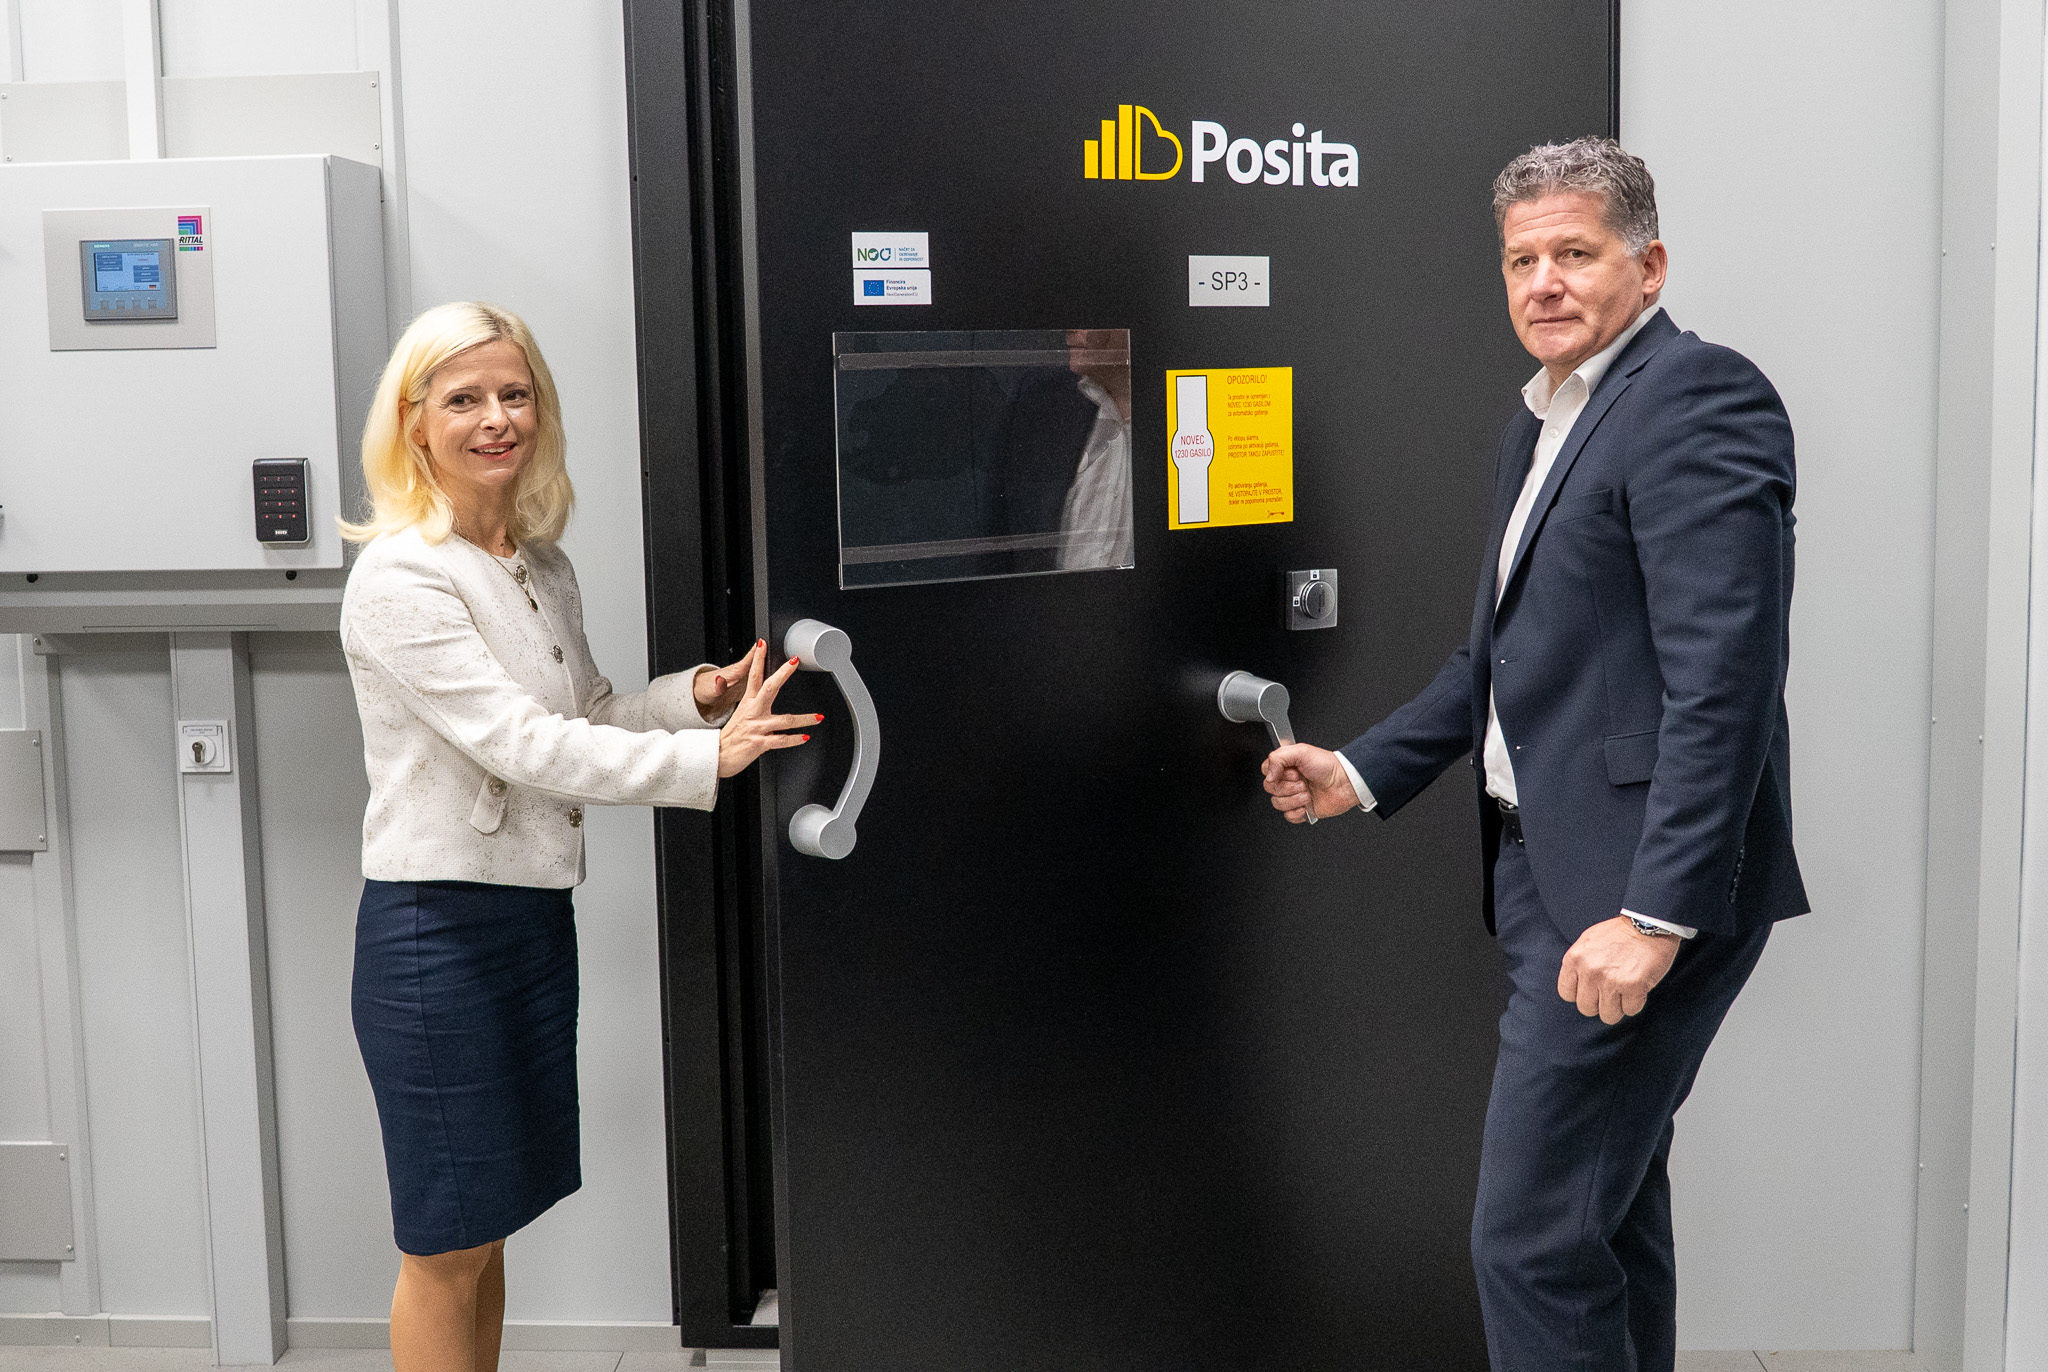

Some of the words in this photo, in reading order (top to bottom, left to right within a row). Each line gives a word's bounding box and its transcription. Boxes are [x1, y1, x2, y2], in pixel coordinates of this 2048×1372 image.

[1191, 120, 1359, 188] Posita
[178, 236, 203, 244] RITTAL
[1211, 271, 1248, 291] SP3
[1227, 374, 1268, 385] OPOZORILO!
[1180, 434, 1205, 445] NOVEC
[1174, 448, 1189, 458] 1230
[1189, 447, 1212, 458] GASILO
